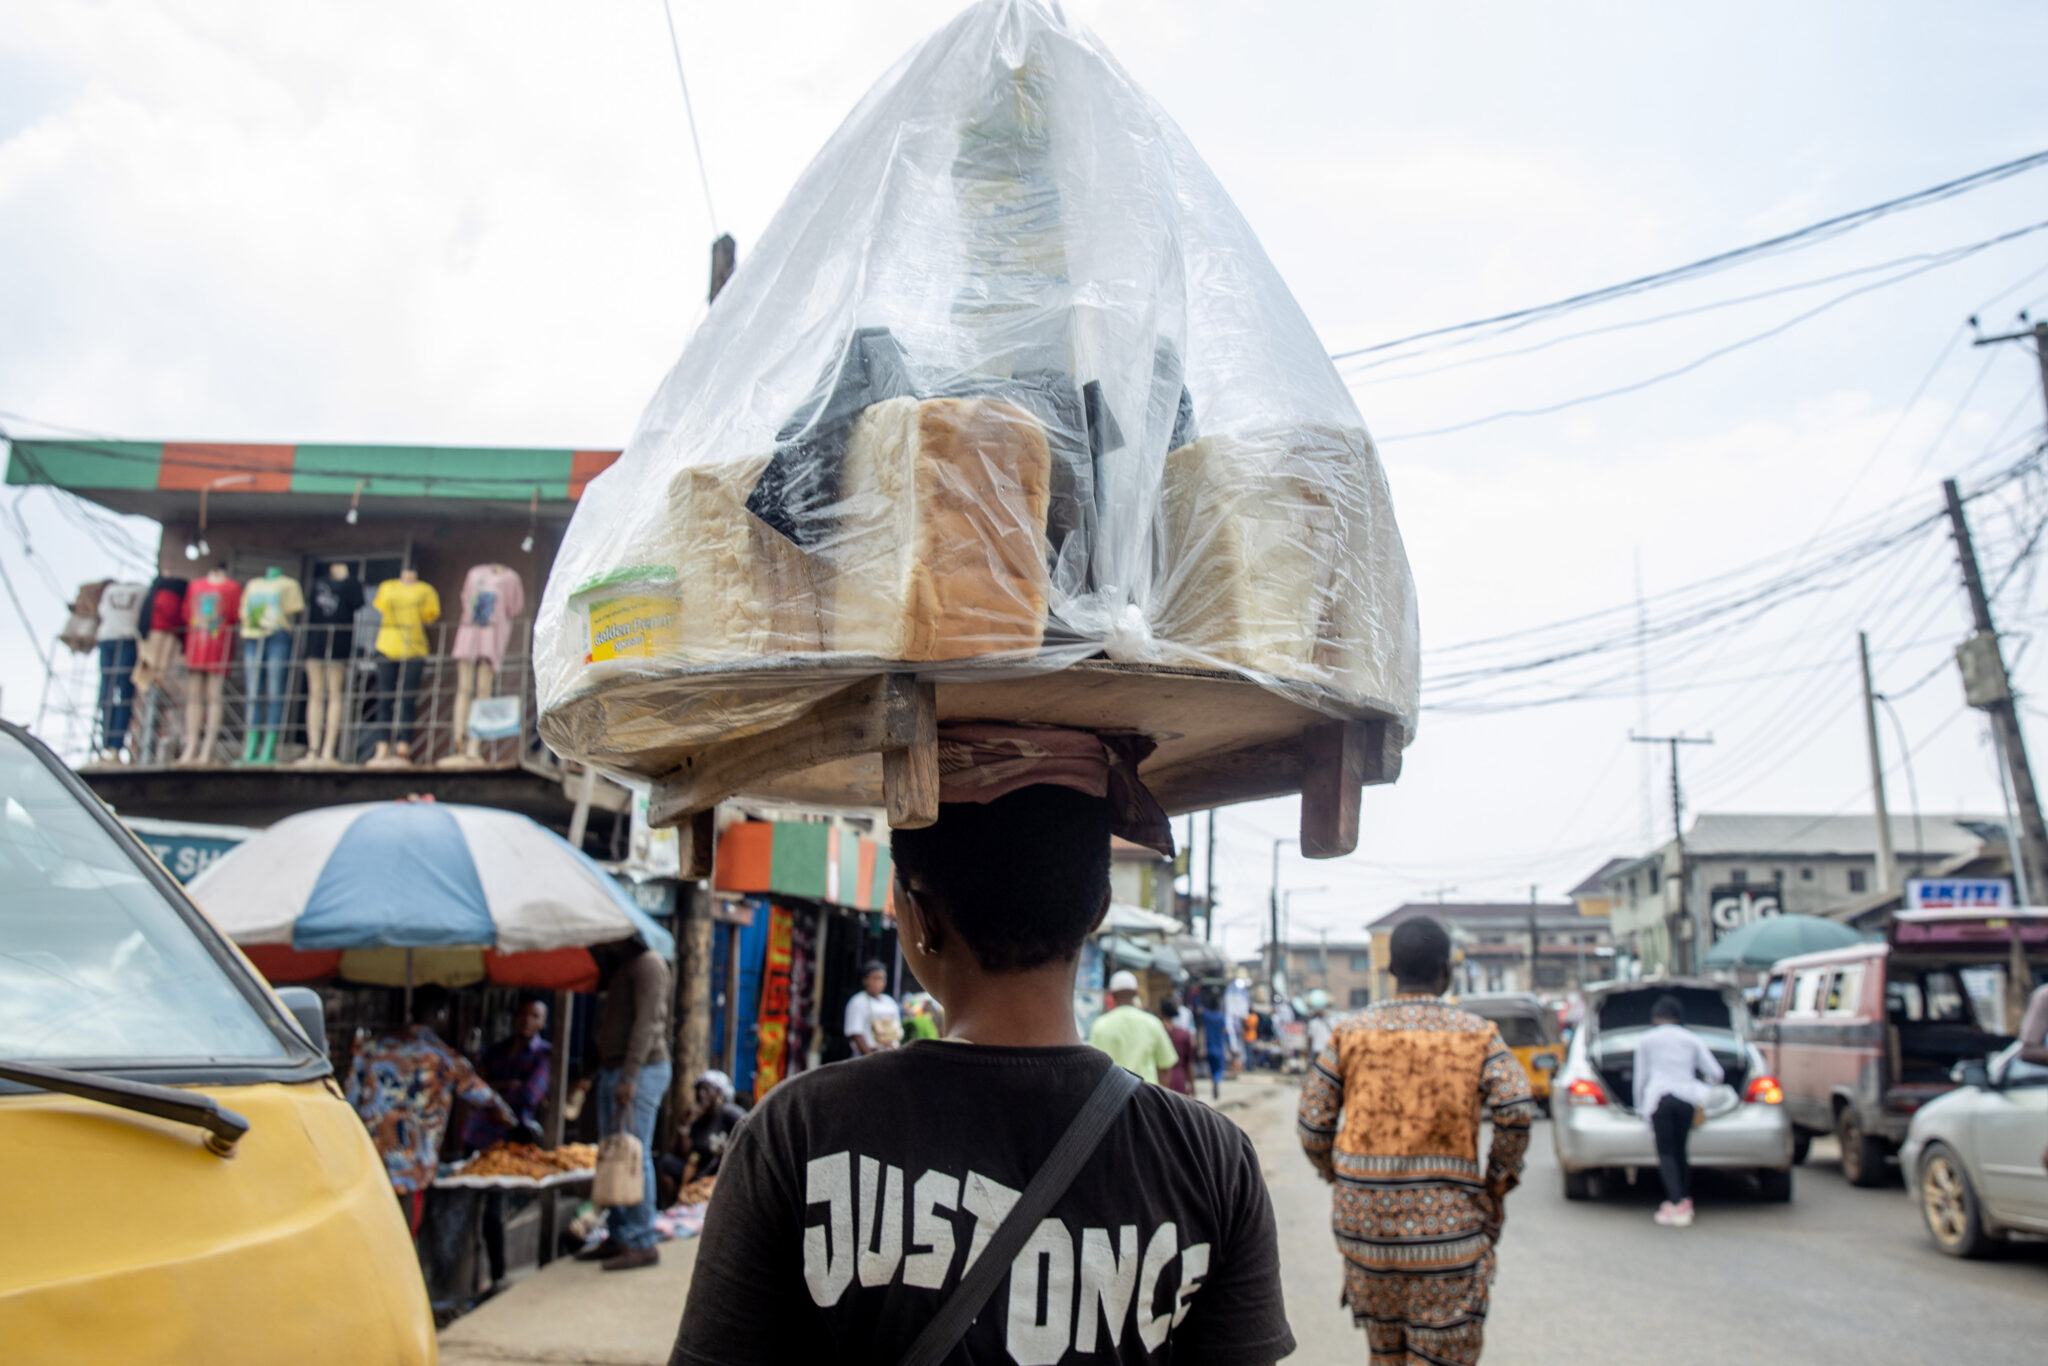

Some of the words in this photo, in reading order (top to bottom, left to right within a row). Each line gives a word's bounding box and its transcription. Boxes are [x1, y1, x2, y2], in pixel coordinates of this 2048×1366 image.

[593, 622, 631, 647] Golden
[632, 613, 673, 633] Penny
[1919, 884, 2001, 900] EKITI
[803, 1150, 1023, 1312] JUST
[1006, 1217, 1211, 1366] ONCE
